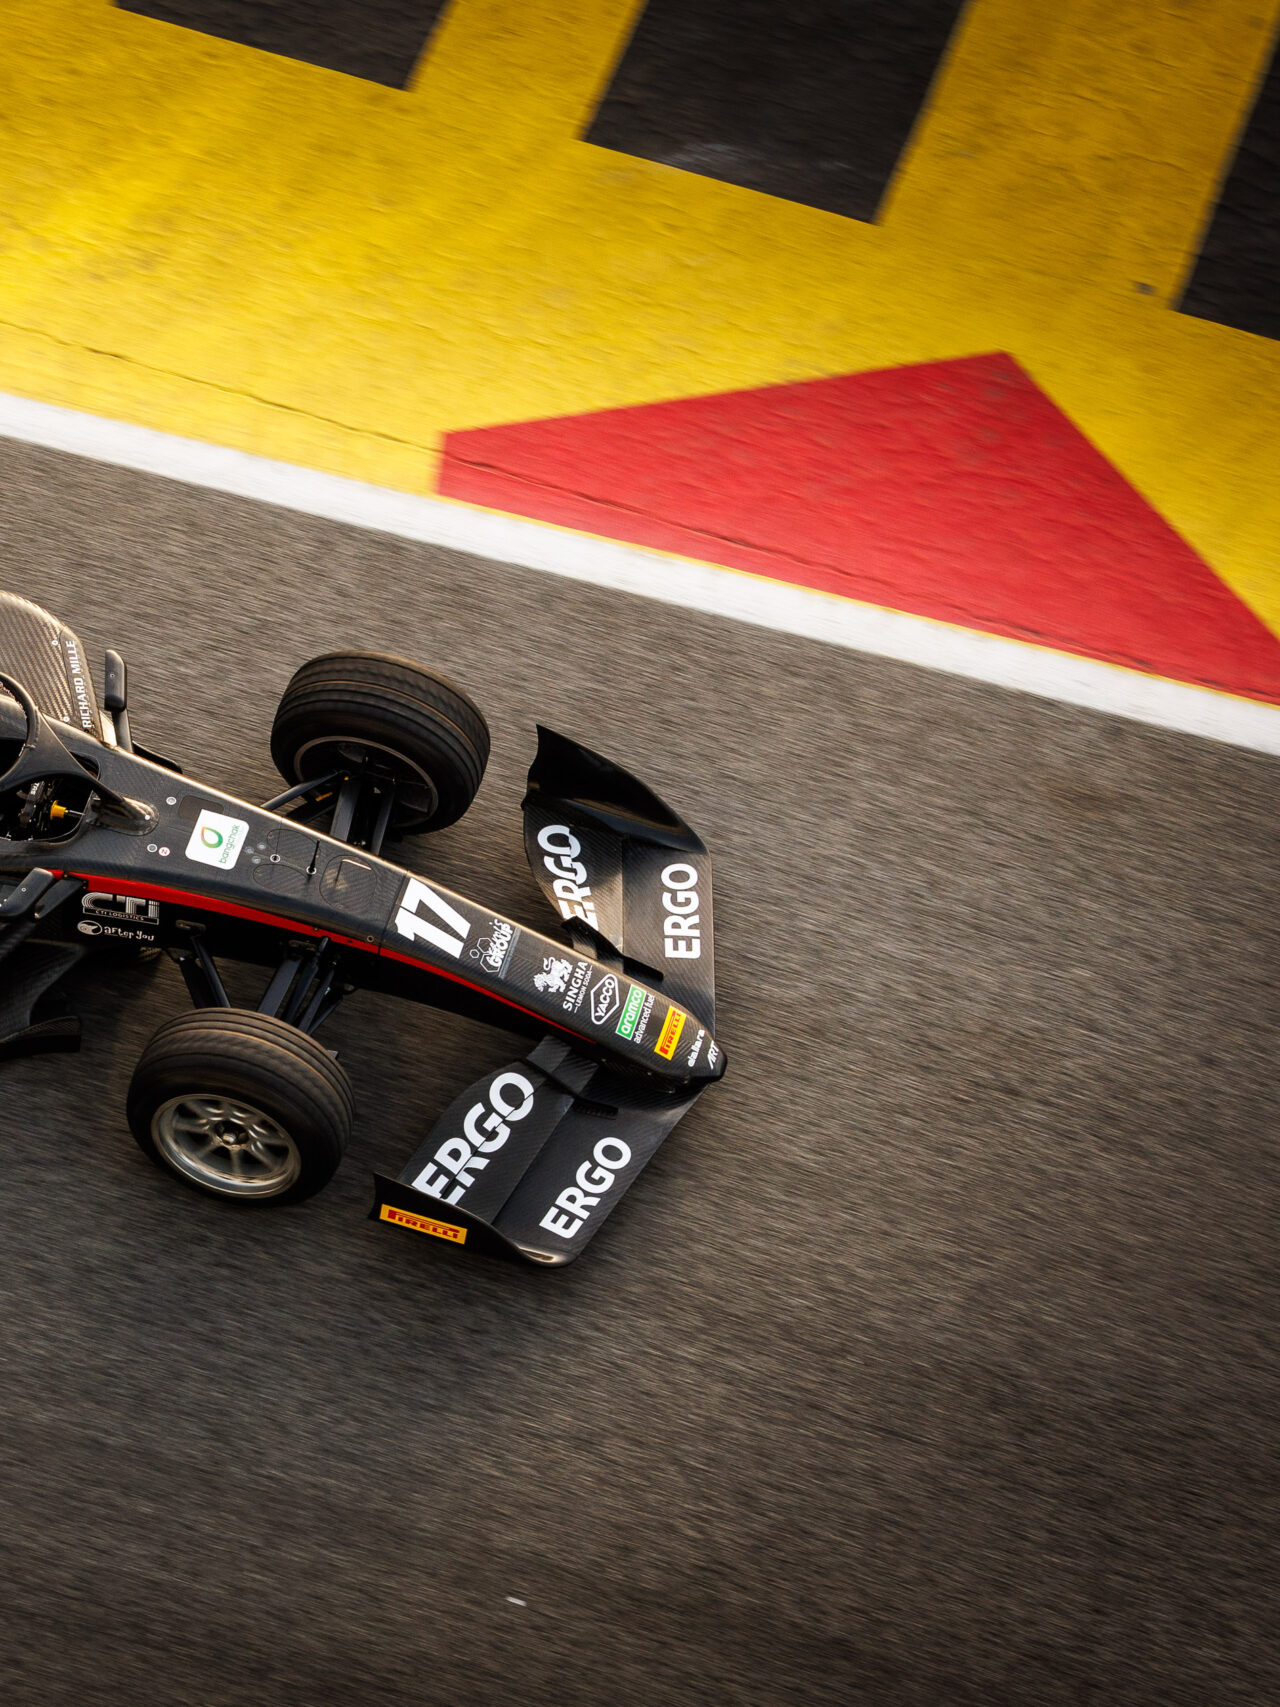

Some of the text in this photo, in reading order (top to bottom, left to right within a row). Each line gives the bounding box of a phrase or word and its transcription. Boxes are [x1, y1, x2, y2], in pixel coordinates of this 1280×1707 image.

[65, 640, 93, 729] RICHARD MILLE
[218, 824, 241, 864] bangchak
[537, 824, 599, 931] ERGO
[81, 892, 160, 918] CTI
[395, 877, 471, 959] 17
[660, 863, 701, 959] ERGO
[486, 923, 513, 967] GROUP
[562, 961, 589, 1012] SINGHA
[594, 978, 615, 1017] YACCO
[621, 990, 643, 1034] aramco
[633, 993, 655, 1044] advanced fuel
[659, 1010, 682, 1056] PIRELLI
[687, 1029, 705, 1068] dallara
[412, 1072, 535, 1205] ERGO
[539, 1137, 632, 1239] ERGO
[387, 1209, 460, 1239] PIRELLI
